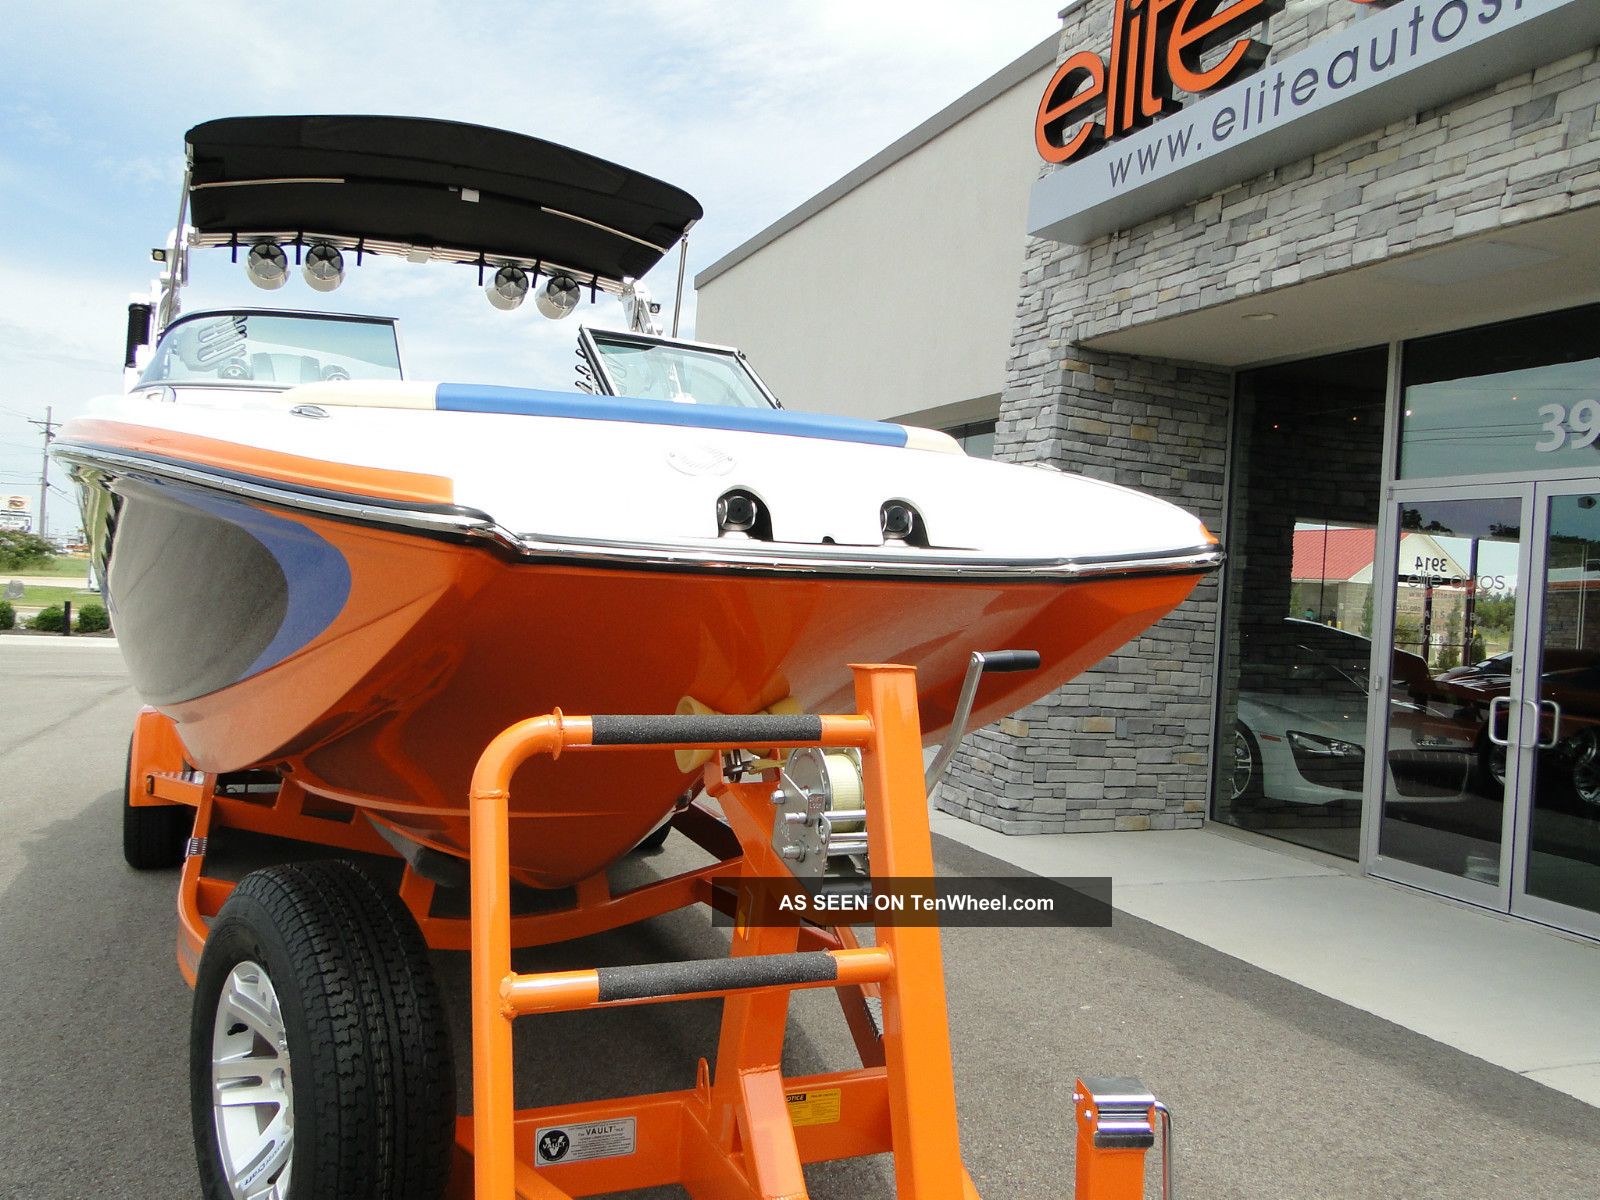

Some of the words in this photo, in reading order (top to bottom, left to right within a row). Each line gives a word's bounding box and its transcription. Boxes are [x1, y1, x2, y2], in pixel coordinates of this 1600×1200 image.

[1035, 0, 1264, 164] elite
[1109, 0, 1522, 188] www.eliteautos
[1535, 399, 1600, 452] 39
[1407, 570, 1442, 588] elite
[786, 1094, 805, 1102] OTICE
[586, 1126, 614, 1135] VAULT
